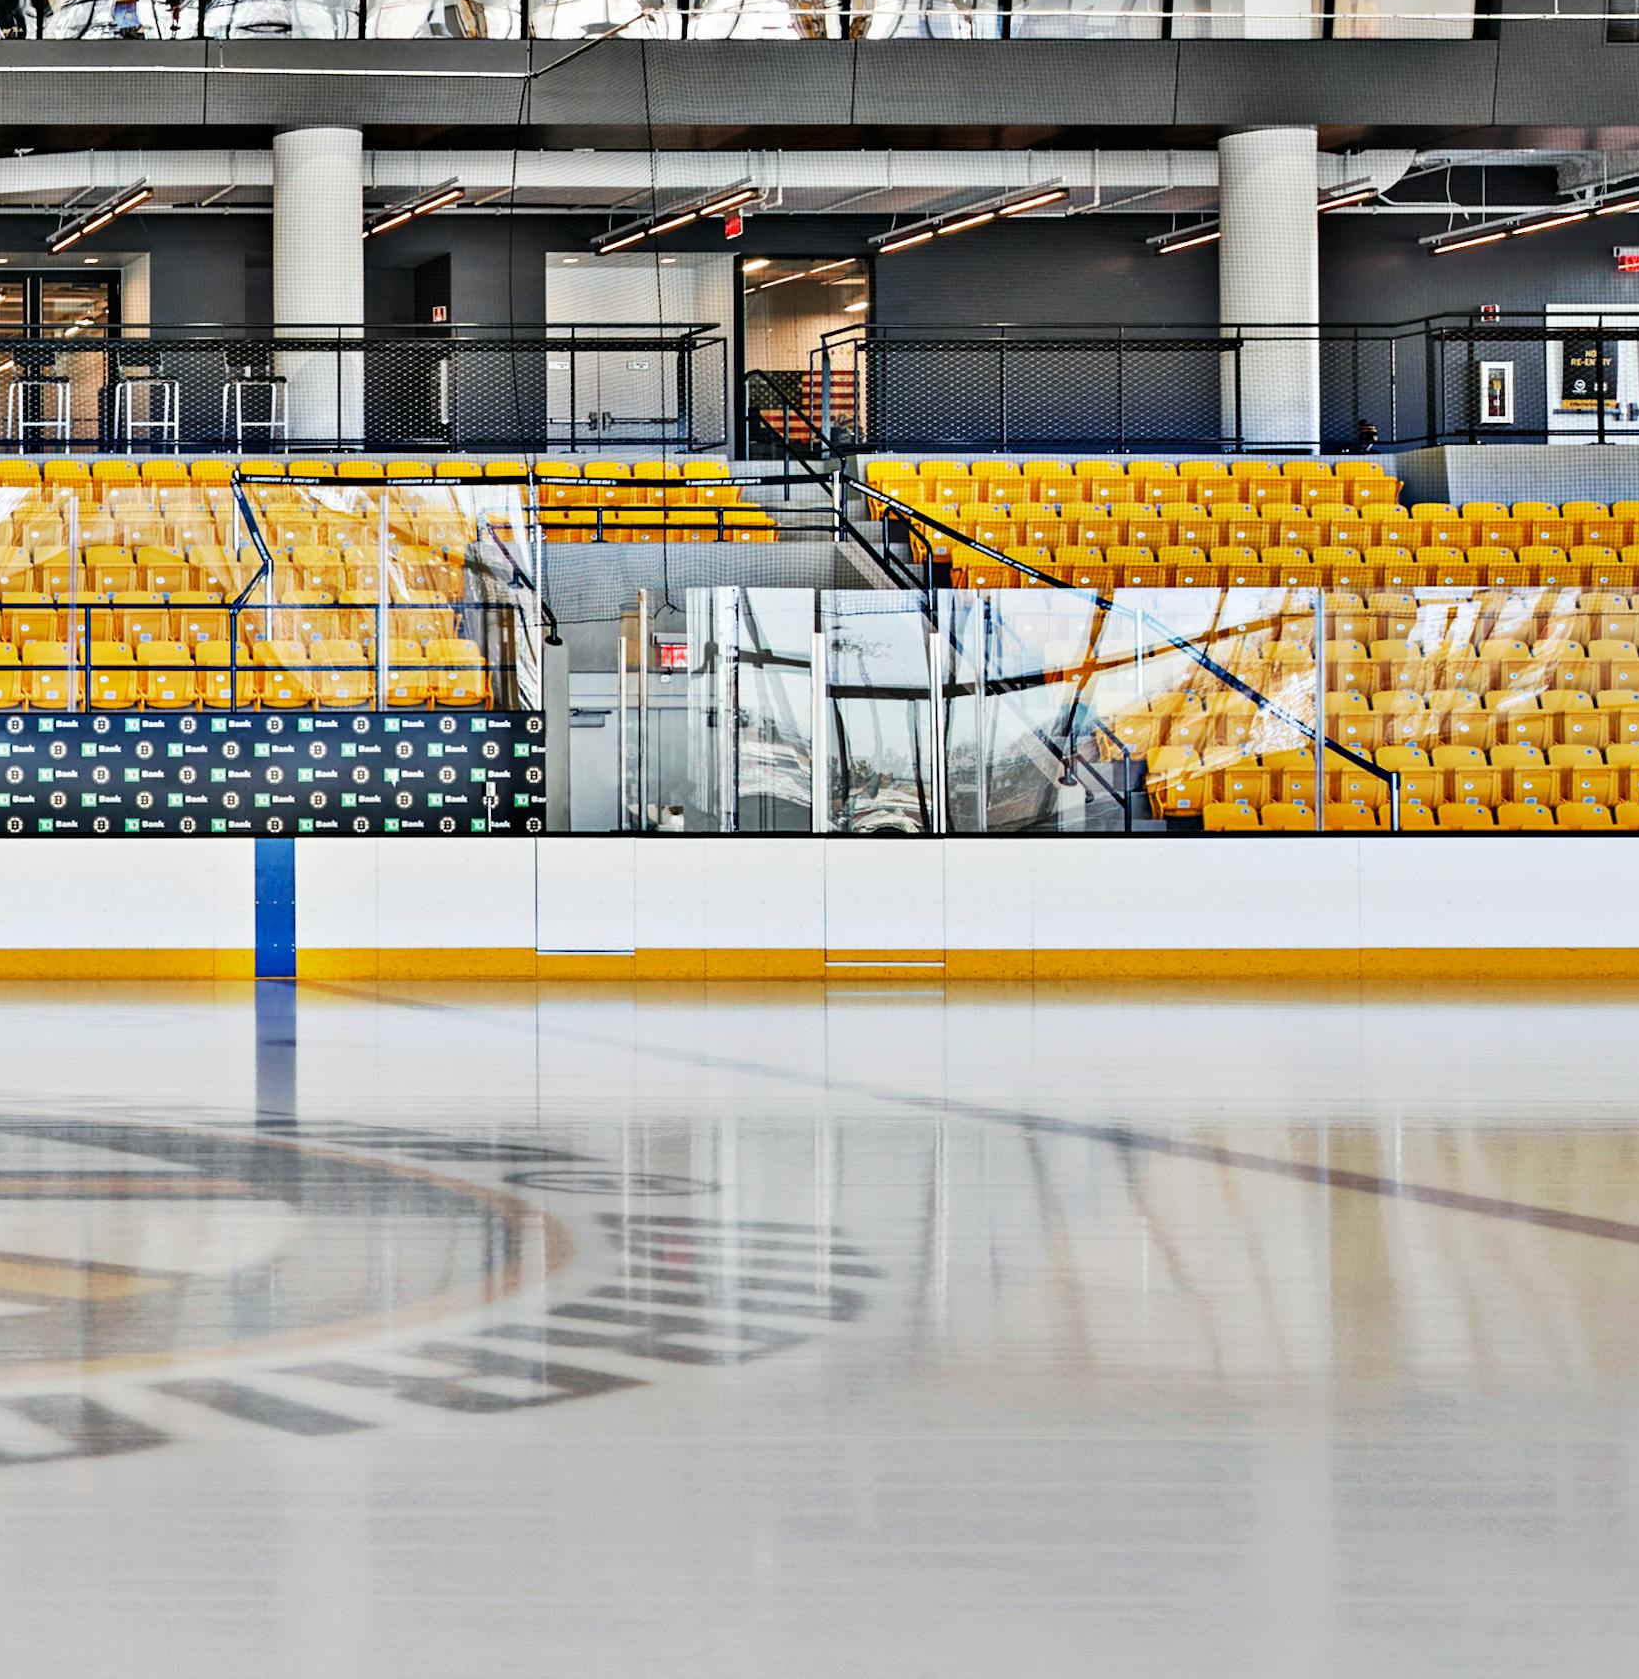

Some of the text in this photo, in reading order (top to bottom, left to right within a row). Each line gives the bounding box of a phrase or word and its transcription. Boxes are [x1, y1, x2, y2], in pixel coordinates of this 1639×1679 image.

[55, 819, 78, 828] Bank
[142, 819, 165, 828] Bank
[228, 819, 251, 828] Bank
[315, 819, 338, 828] Bank
[401, 819, 424, 828] Bank
